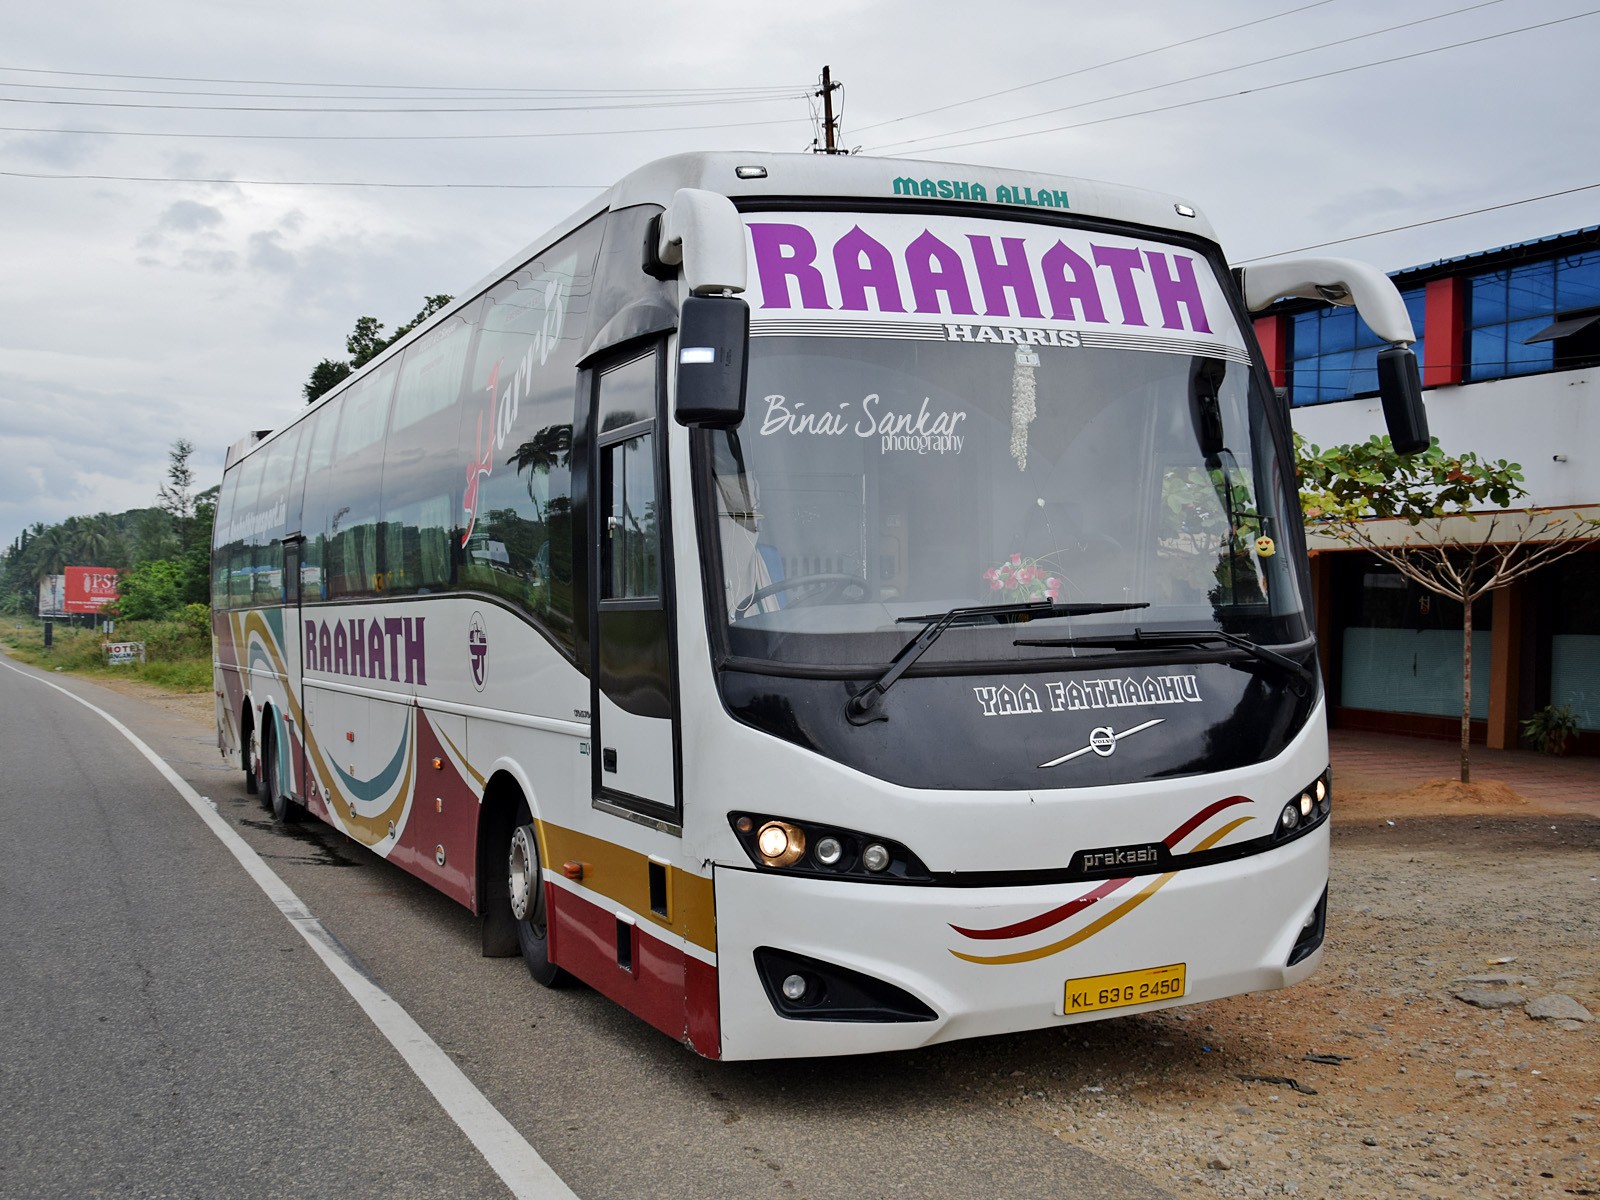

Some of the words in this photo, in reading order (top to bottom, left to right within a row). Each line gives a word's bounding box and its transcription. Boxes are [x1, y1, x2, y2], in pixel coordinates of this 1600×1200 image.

[893, 177, 987, 201] MASHA
[996, 184, 1070, 209] ALLAH
[745, 223, 1213, 334] RAAHATH
[945, 324, 1082, 348] HARRIS
[304, 616, 427, 686] RAAHATH
[973, 684, 1042, 716] YAA
[1046, 674, 1203, 712] FATHAAHU
[1082, 845, 1158, 872] prakash
[1072, 992, 1094, 1008] KL
[1099, 988, 1120, 1004] 63
[1124, 986, 1134, 1001] G
[1139, 978, 1180, 998] 2450
